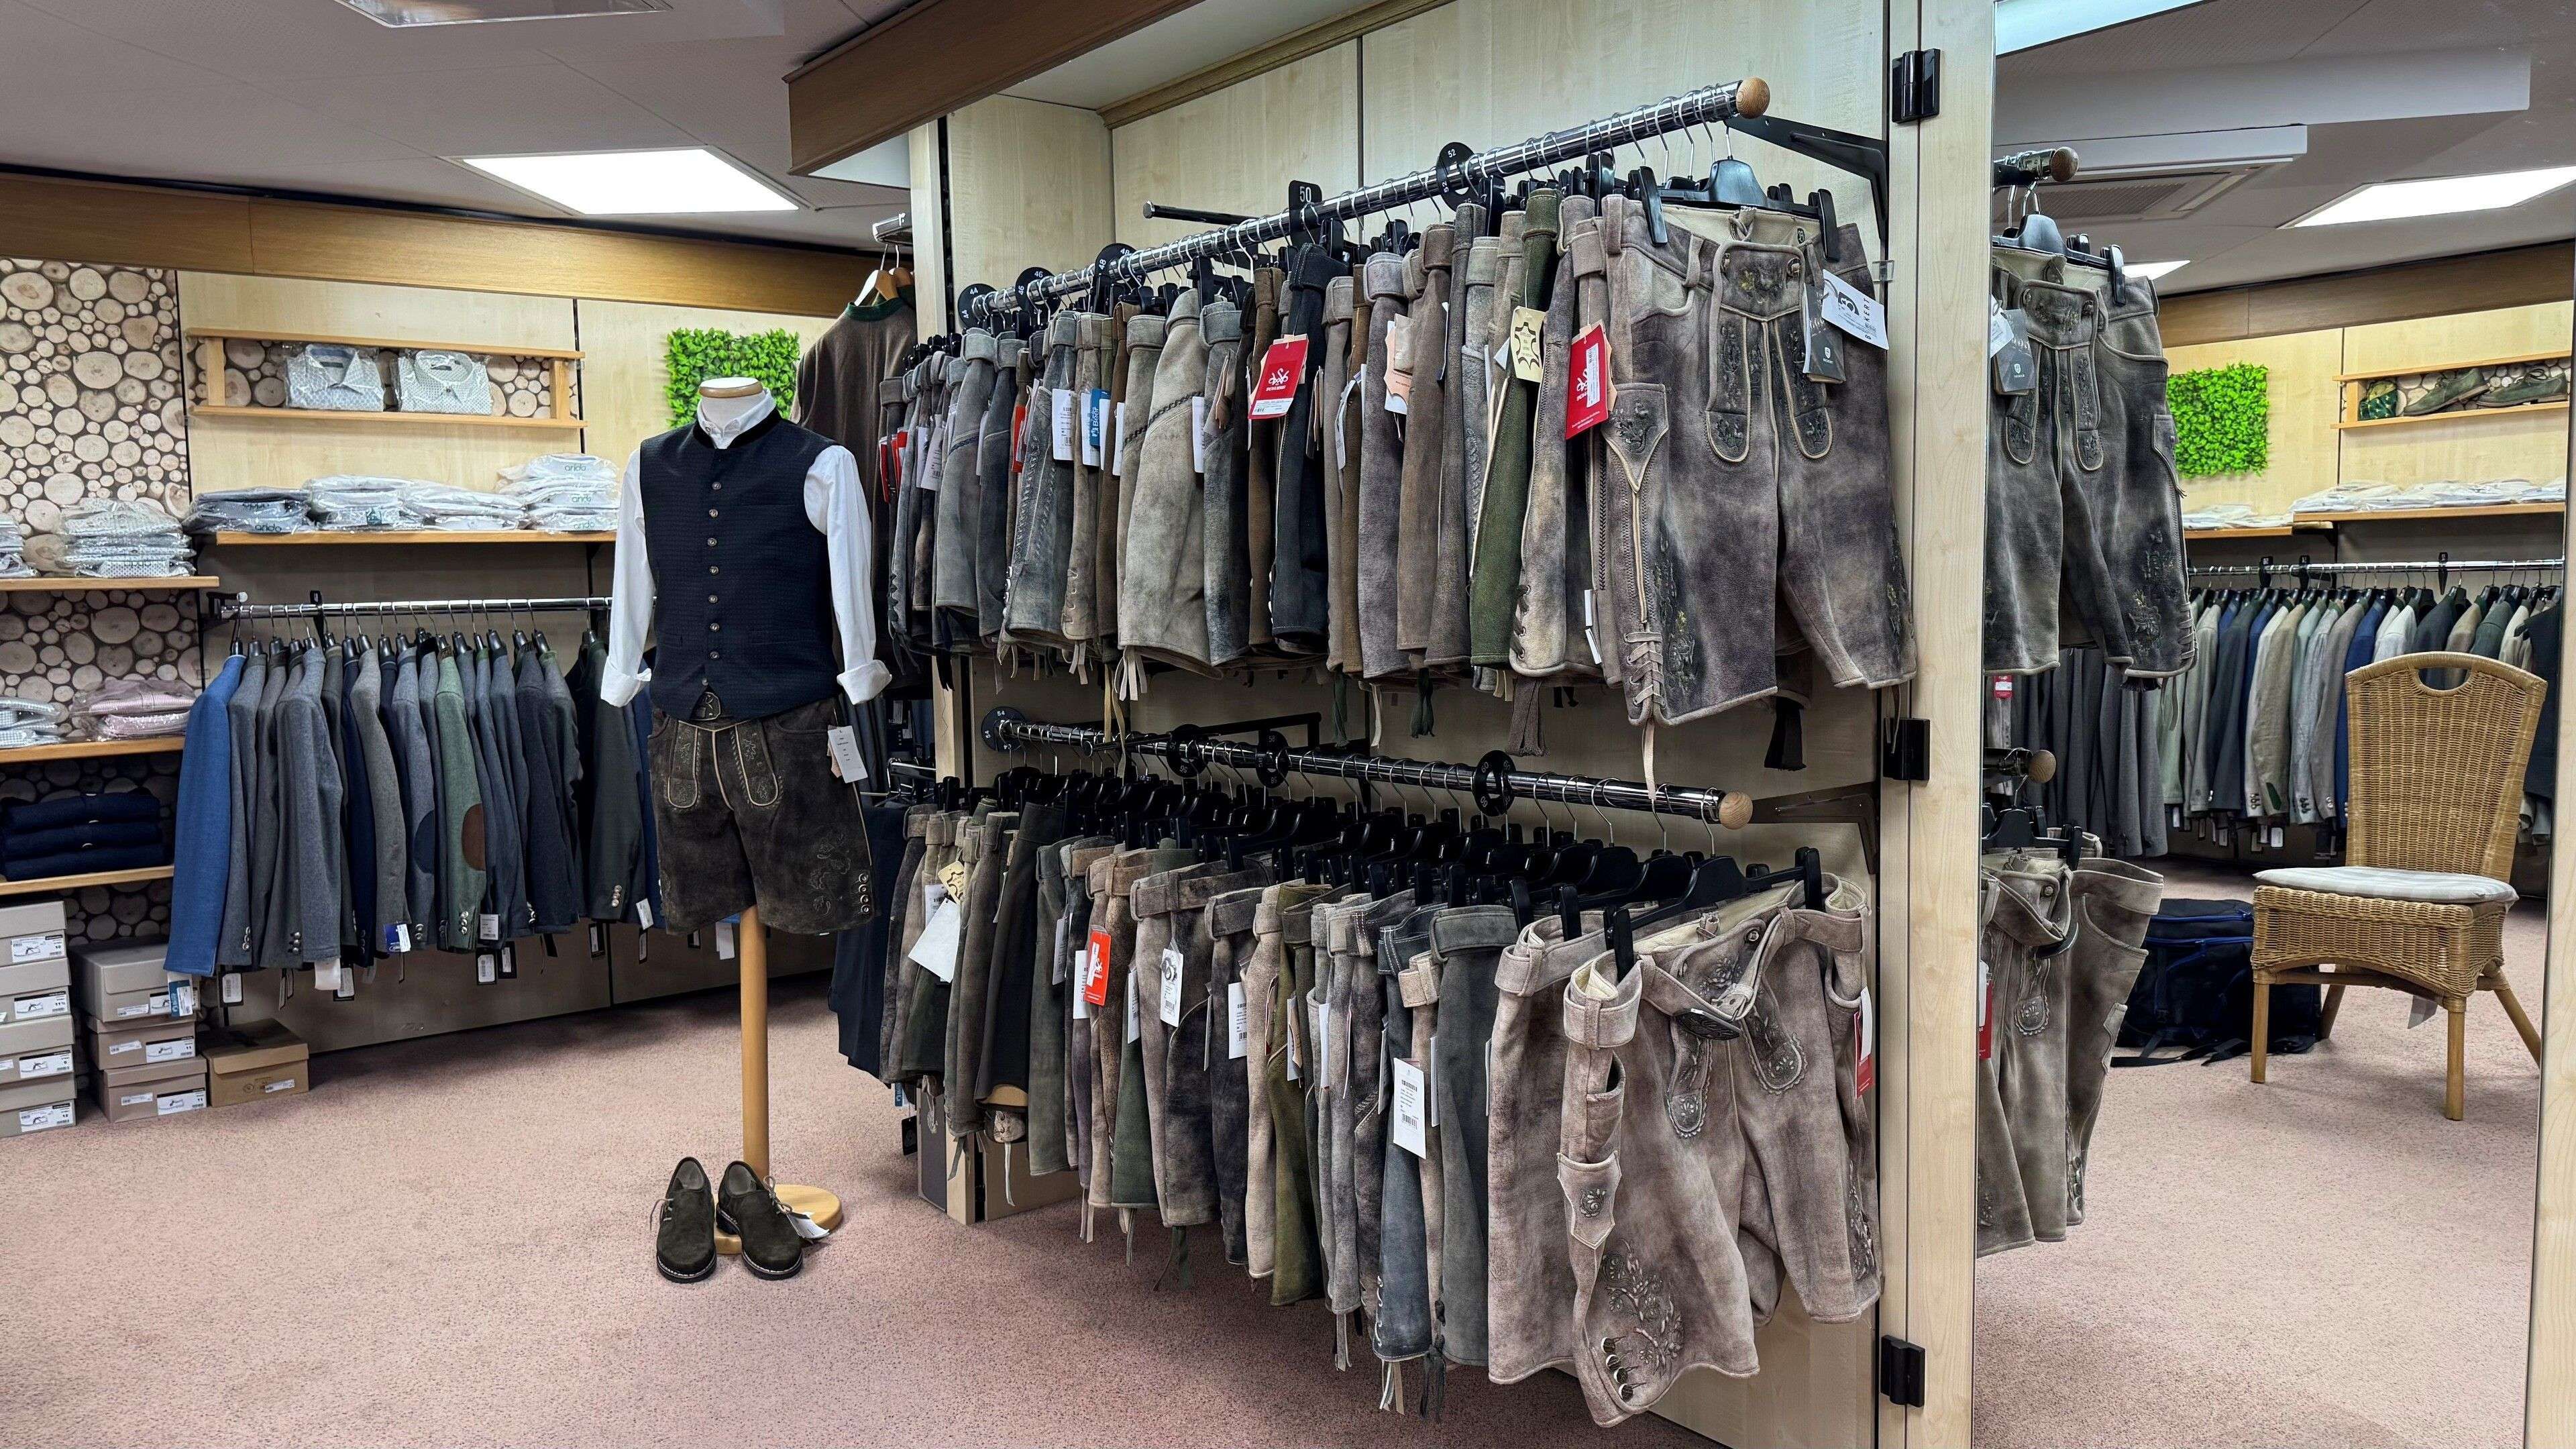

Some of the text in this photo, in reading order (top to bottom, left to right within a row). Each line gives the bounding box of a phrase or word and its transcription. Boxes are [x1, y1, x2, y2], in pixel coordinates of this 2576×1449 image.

[1448, 149, 1456, 158] 52
[1299, 186, 1311, 203] 50
[1098, 259, 1106, 270] 48
[1018, 285, 1024, 295] 46
[961, 309, 969, 319] 44
[564, 463, 587, 472] arido
[1481, 761, 1489, 773] 60
